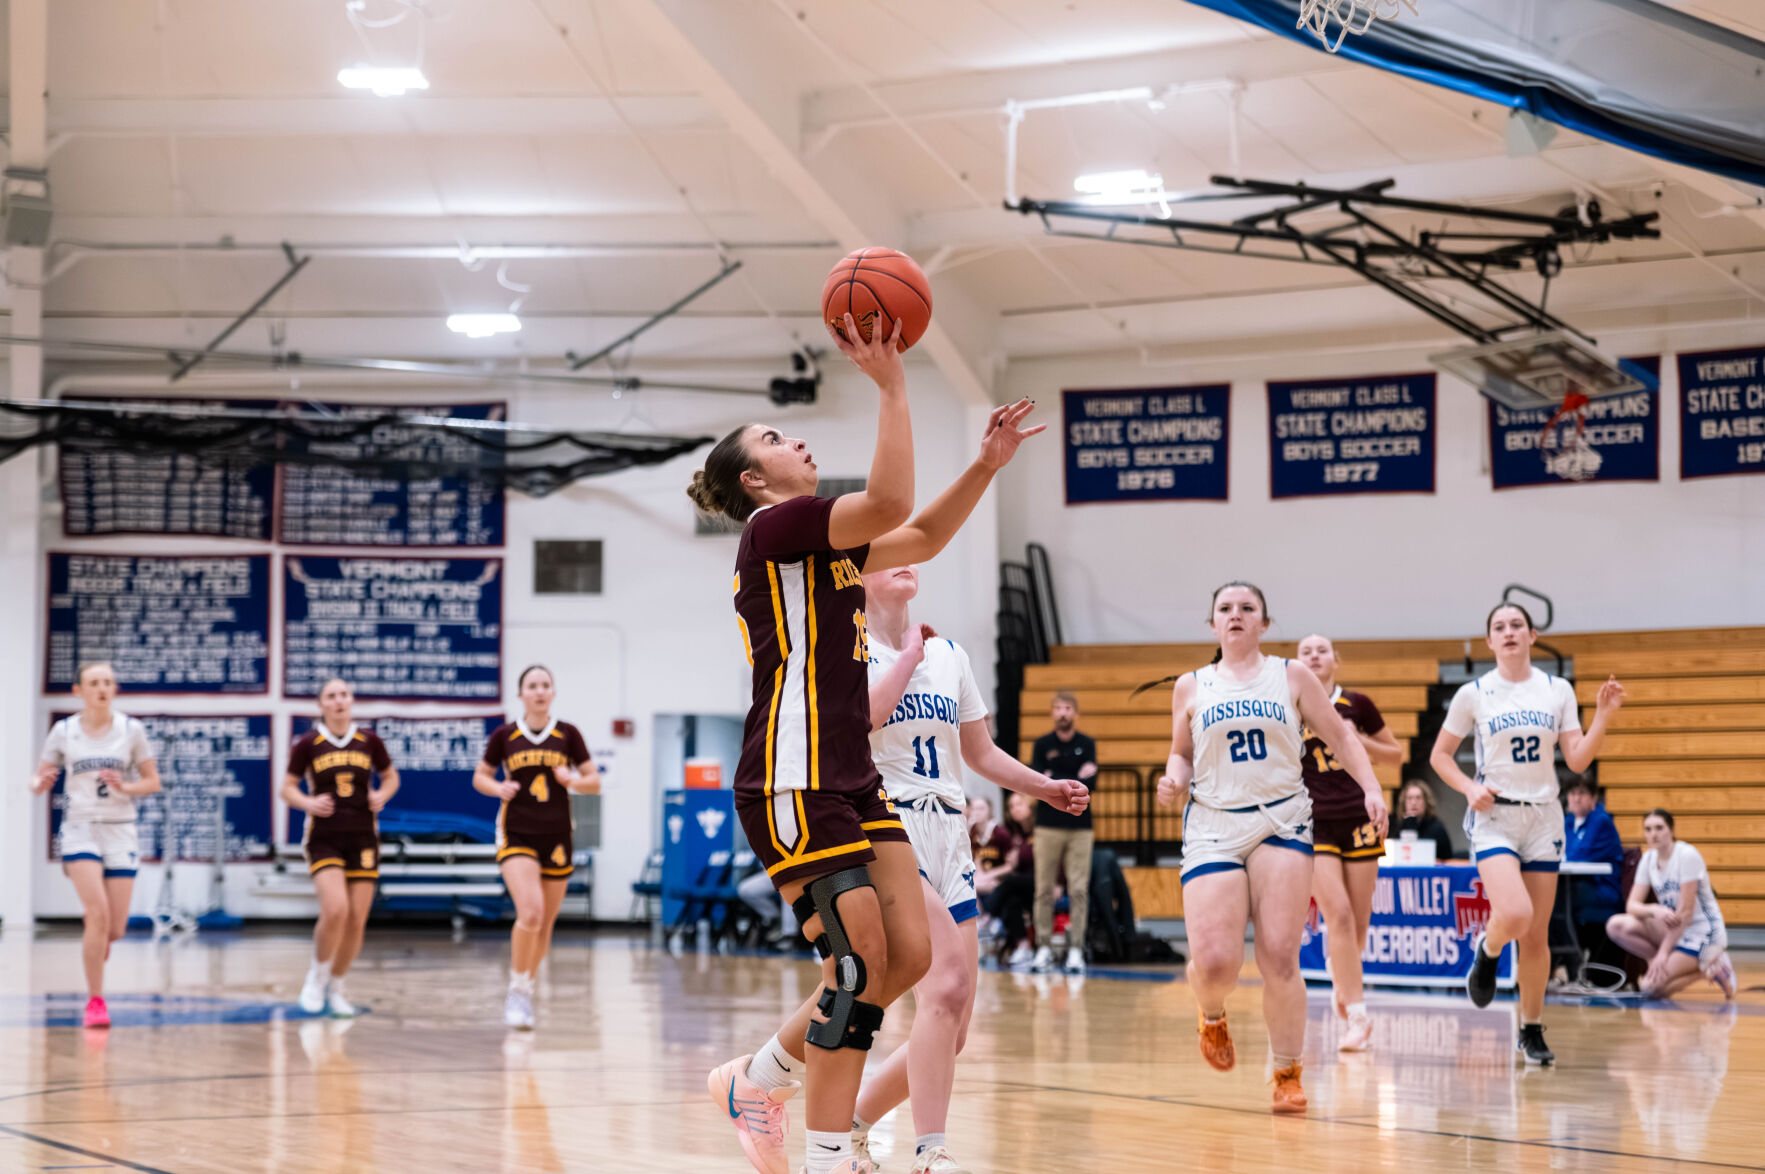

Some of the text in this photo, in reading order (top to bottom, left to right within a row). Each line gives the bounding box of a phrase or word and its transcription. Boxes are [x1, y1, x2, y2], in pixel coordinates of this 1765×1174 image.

[1697, 358, 1757, 381] VERMONT
[1083, 396, 1144, 418] VERMONT
[1148, 394, 1193, 416] CLASS
[1290, 387, 1350, 409] VERMONT
[1355, 384, 1399, 406] CLASS
[1688, 386, 1741, 414] STATE
[1070, 416, 1222, 446] STATE CHAMPIONS
[1276, 407, 1427, 438] STATE CHAMPIONS
[1283, 436, 1421, 461] BOYS SOCCER
[1505, 428, 1557, 451] BOYS
[1077, 445, 1214, 469] BOYS SOCCER
[1324, 462, 1380, 483] 1977
[68, 556, 250, 578] STATE CHAMPIONS
[338, 560, 449, 580] VERMONT
[305, 580, 482, 600] STATE CHAMPIONS
[1202, 699, 1288, 732] MISSISQUOI
[1488, 709, 1555, 737] MISSISQUOI
[912, 735, 940, 779] 11
[1227, 728, 1268, 763] 20
[1510, 735, 1541, 764] 22
[335, 771, 355, 797] 5
[529, 773, 549, 802] 4
[1352, 823, 1378, 848] 13
[1398, 876, 1450, 915] VALLEY
[1361, 925, 1460, 965] DERBIRDS
